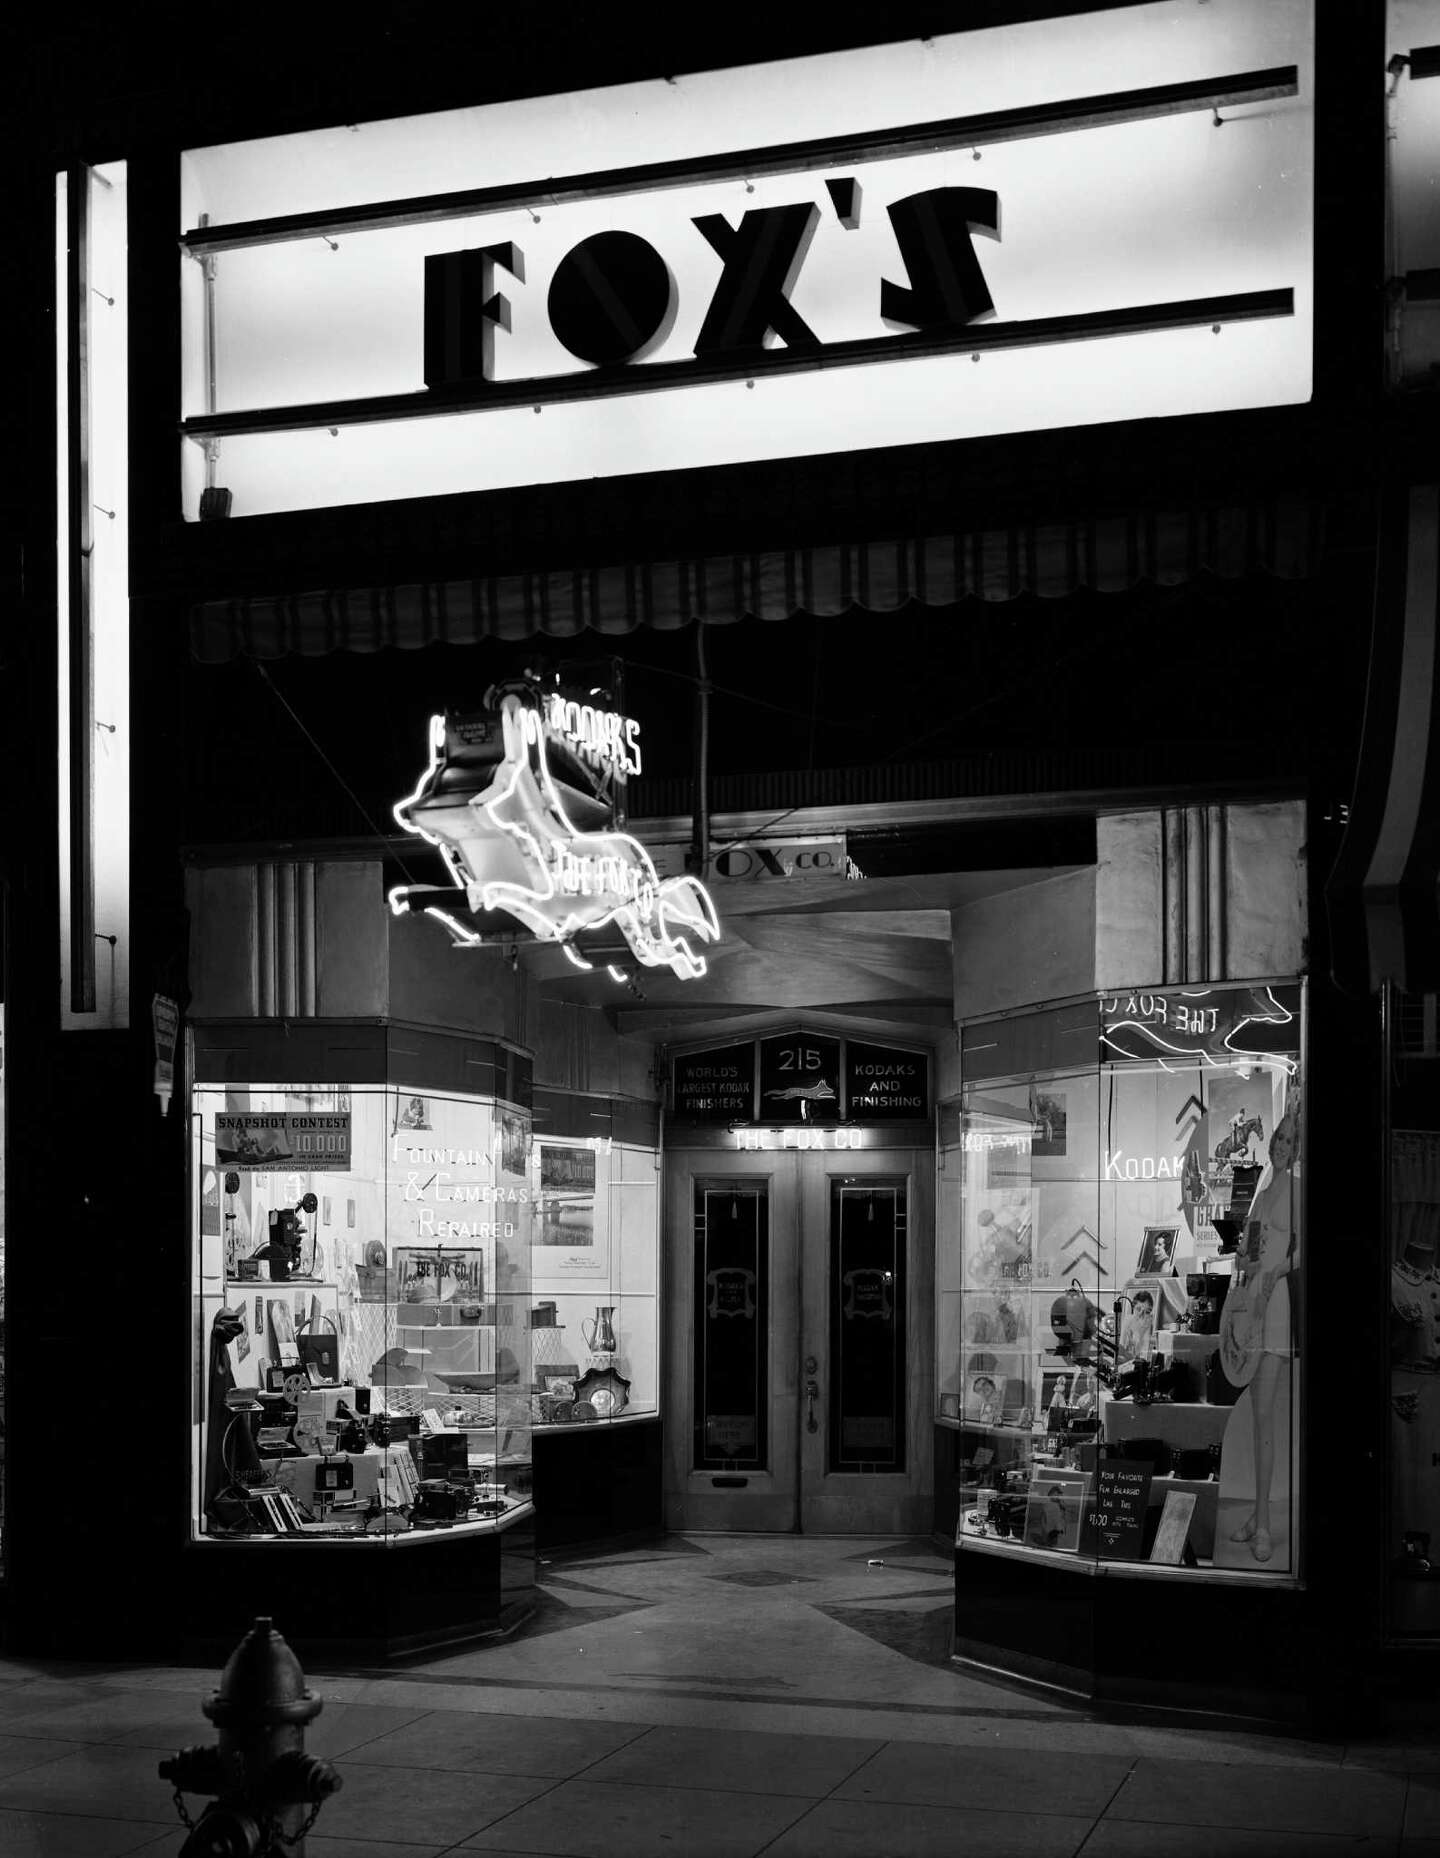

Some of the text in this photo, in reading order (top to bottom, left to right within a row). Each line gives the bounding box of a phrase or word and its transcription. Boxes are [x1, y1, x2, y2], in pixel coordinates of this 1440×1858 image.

[424, 177, 1001, 388] FOX'S
[778, 1050, 822, 1071] 215
[686, 1066, 739, 1078] WORLD'S
[854, 1064, 916, 1077] KODAKS
[719, 1081, 750, 1094] KODAK
[869, 1080, 900, 1092] AND
[685, 1097, 744, 1110] FINISHERS
[851, 1096, 922, 1108] FINISHING
[218, 1117, 348, 1130] SNAPSHOT CONTEST
[783, 1129, 825, 1149] FOX
[392, 1133, 488, 1166] FOUNTAIN
[435, 1172, 528, 1203] CAMERAS
[418, 1208, 514, 1238] REPAIRED
[434, 1262, 451, 1278] FOX
